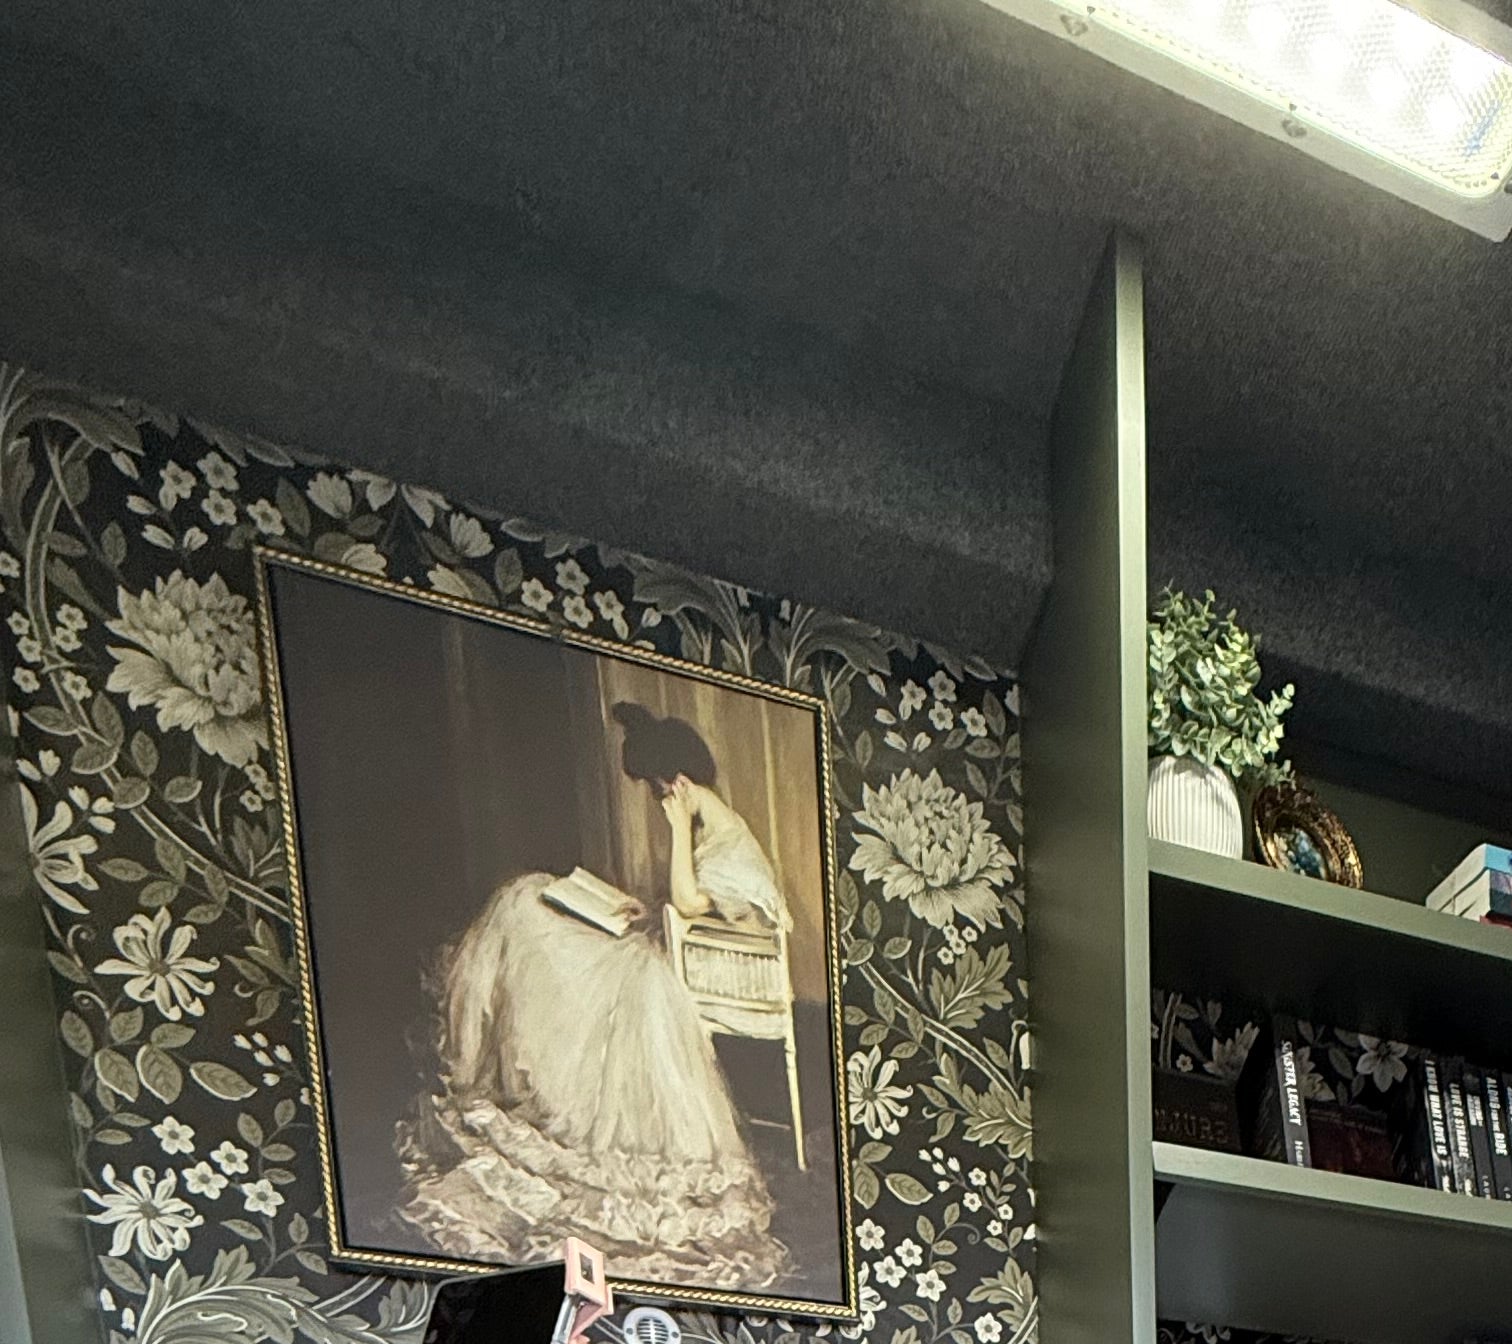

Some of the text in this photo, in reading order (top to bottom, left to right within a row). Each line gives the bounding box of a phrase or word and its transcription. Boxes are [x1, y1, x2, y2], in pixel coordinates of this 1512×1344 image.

[1429, 1094, 1443, 1120] WHAT
[1450, 1083, 1463, 1107] LOVE
[1432, 1120, 1447, 1146] LOVE
[1437, 1146, 1448, 1156] IS
